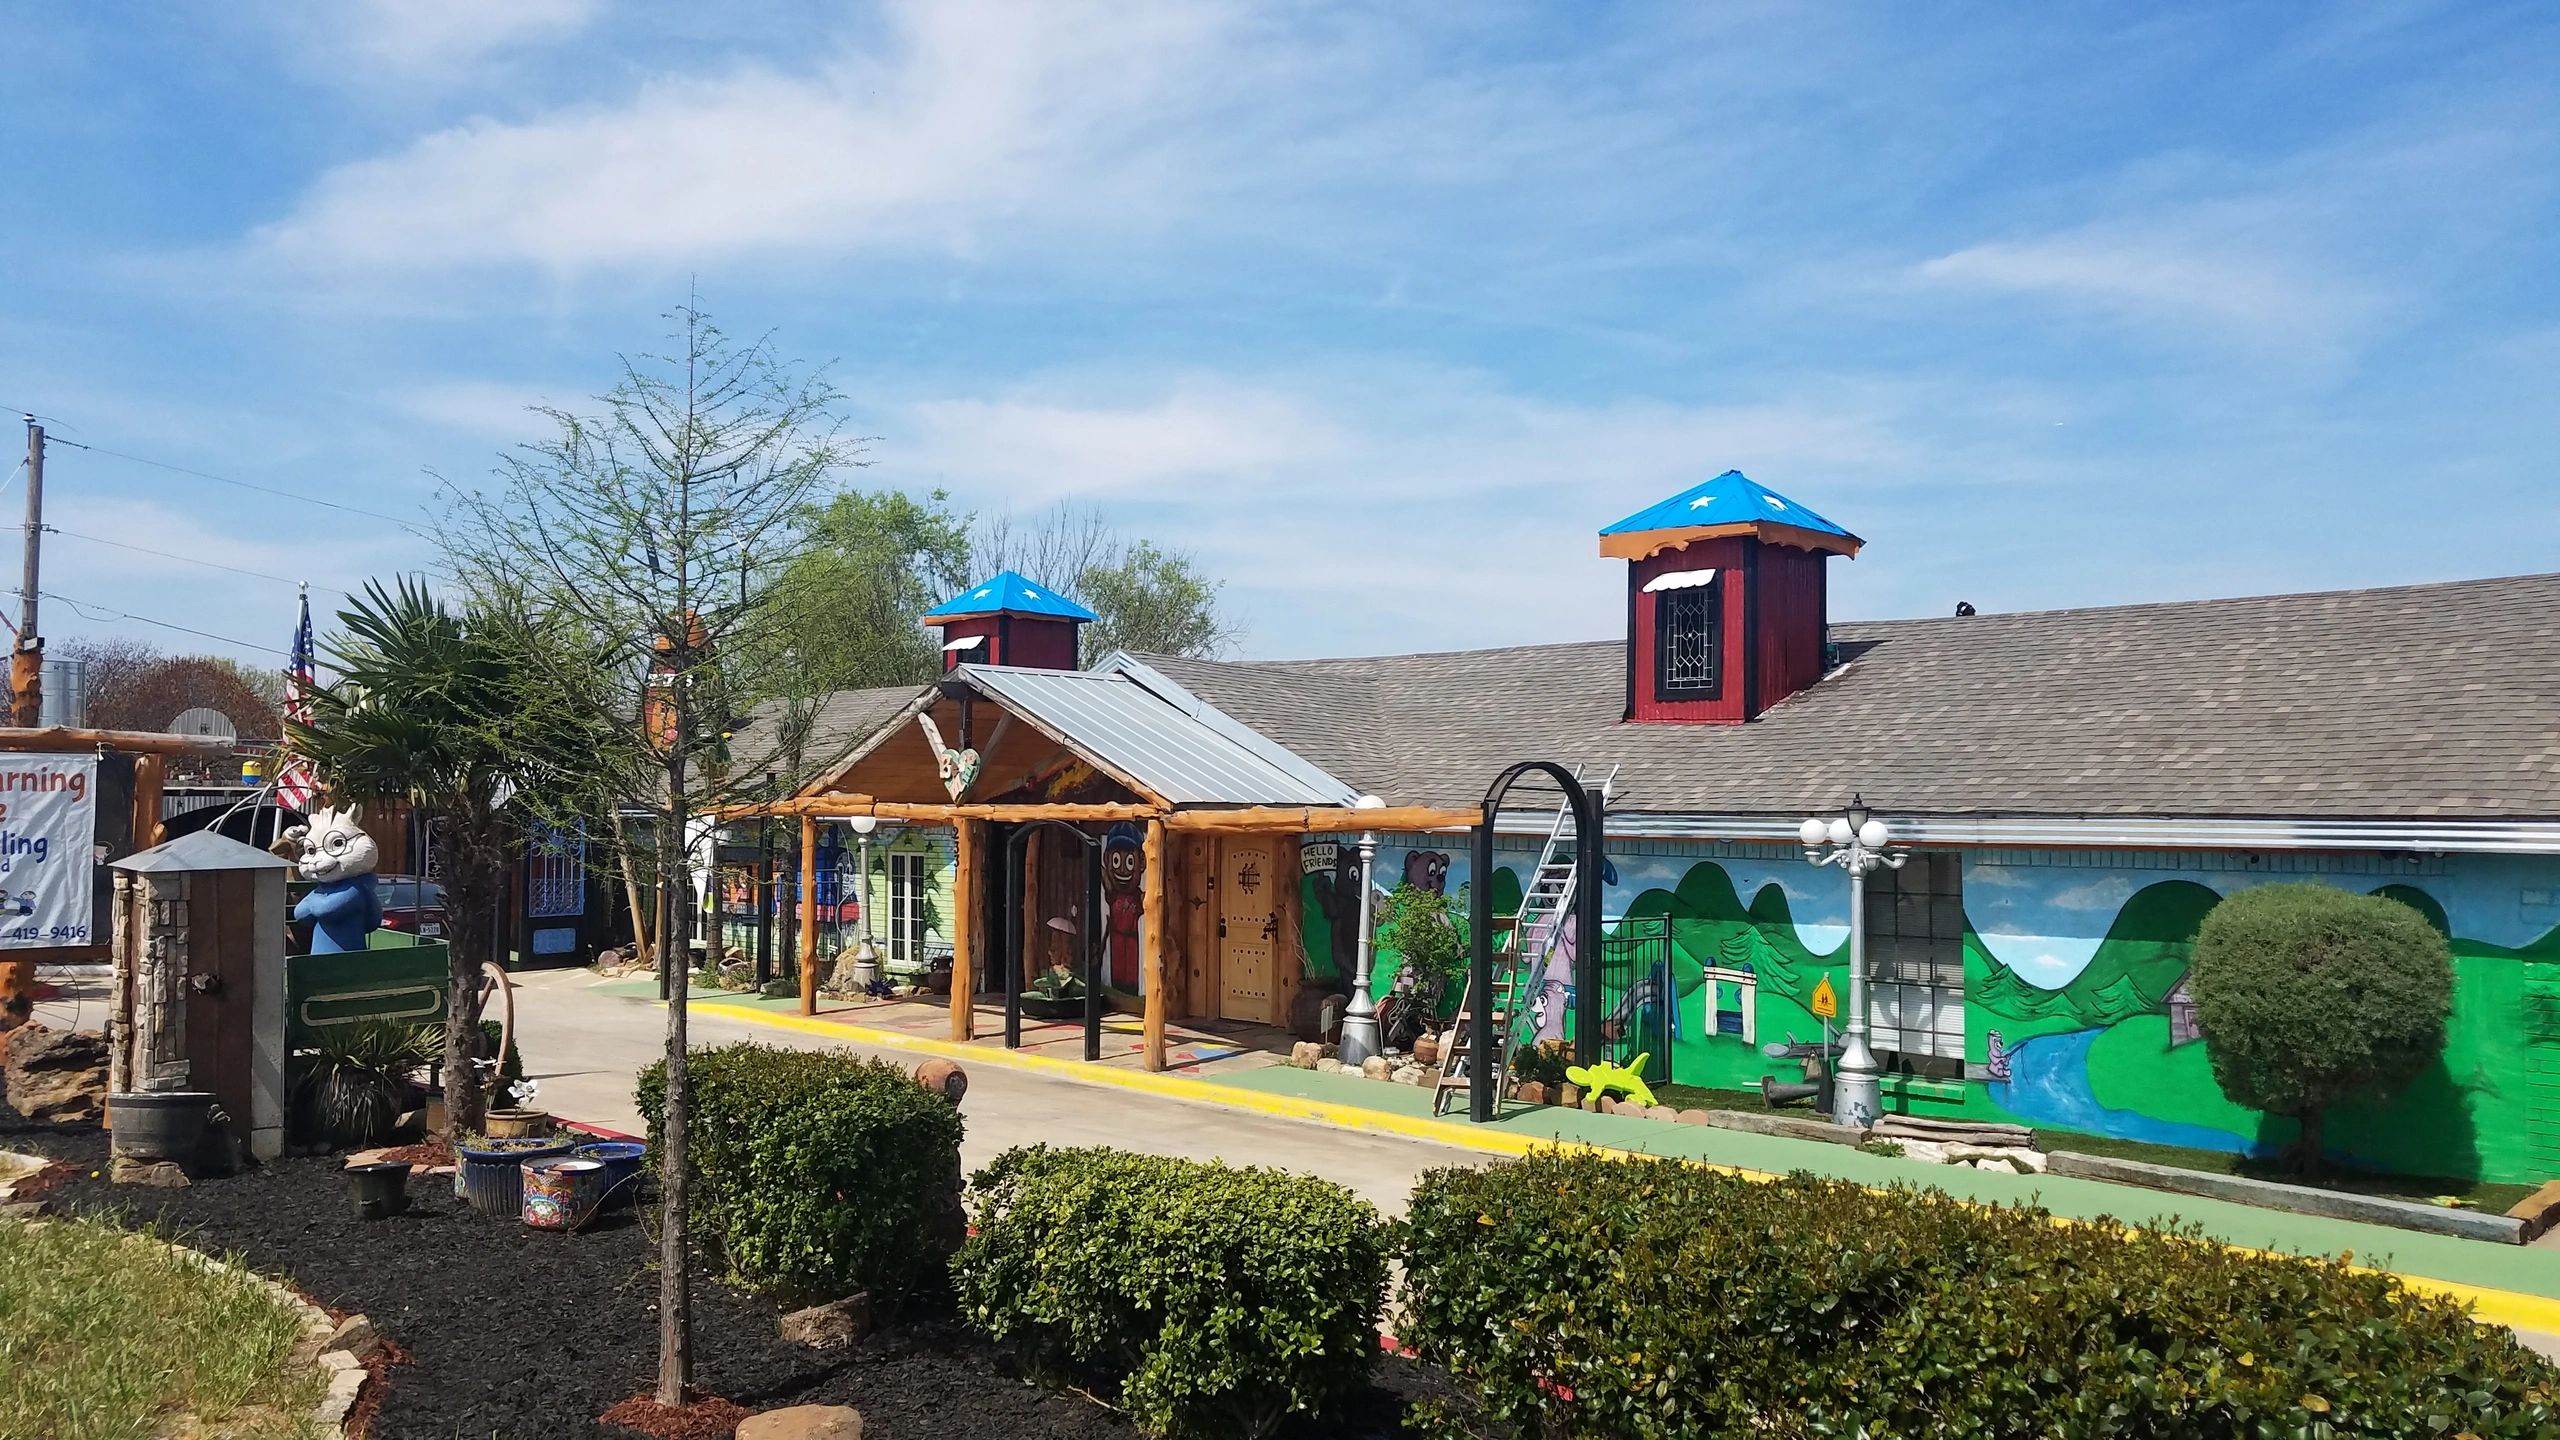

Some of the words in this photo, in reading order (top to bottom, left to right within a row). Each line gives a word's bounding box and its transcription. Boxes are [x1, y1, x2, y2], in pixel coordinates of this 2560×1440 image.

[0, 766, 86, 802] rning
[2, 831, 47, 863] ling
[952, 826, 960, 883] 2331
[1303, 846, 1334, 859] HELLO
[0, 925, 86, 940] -419-9416
